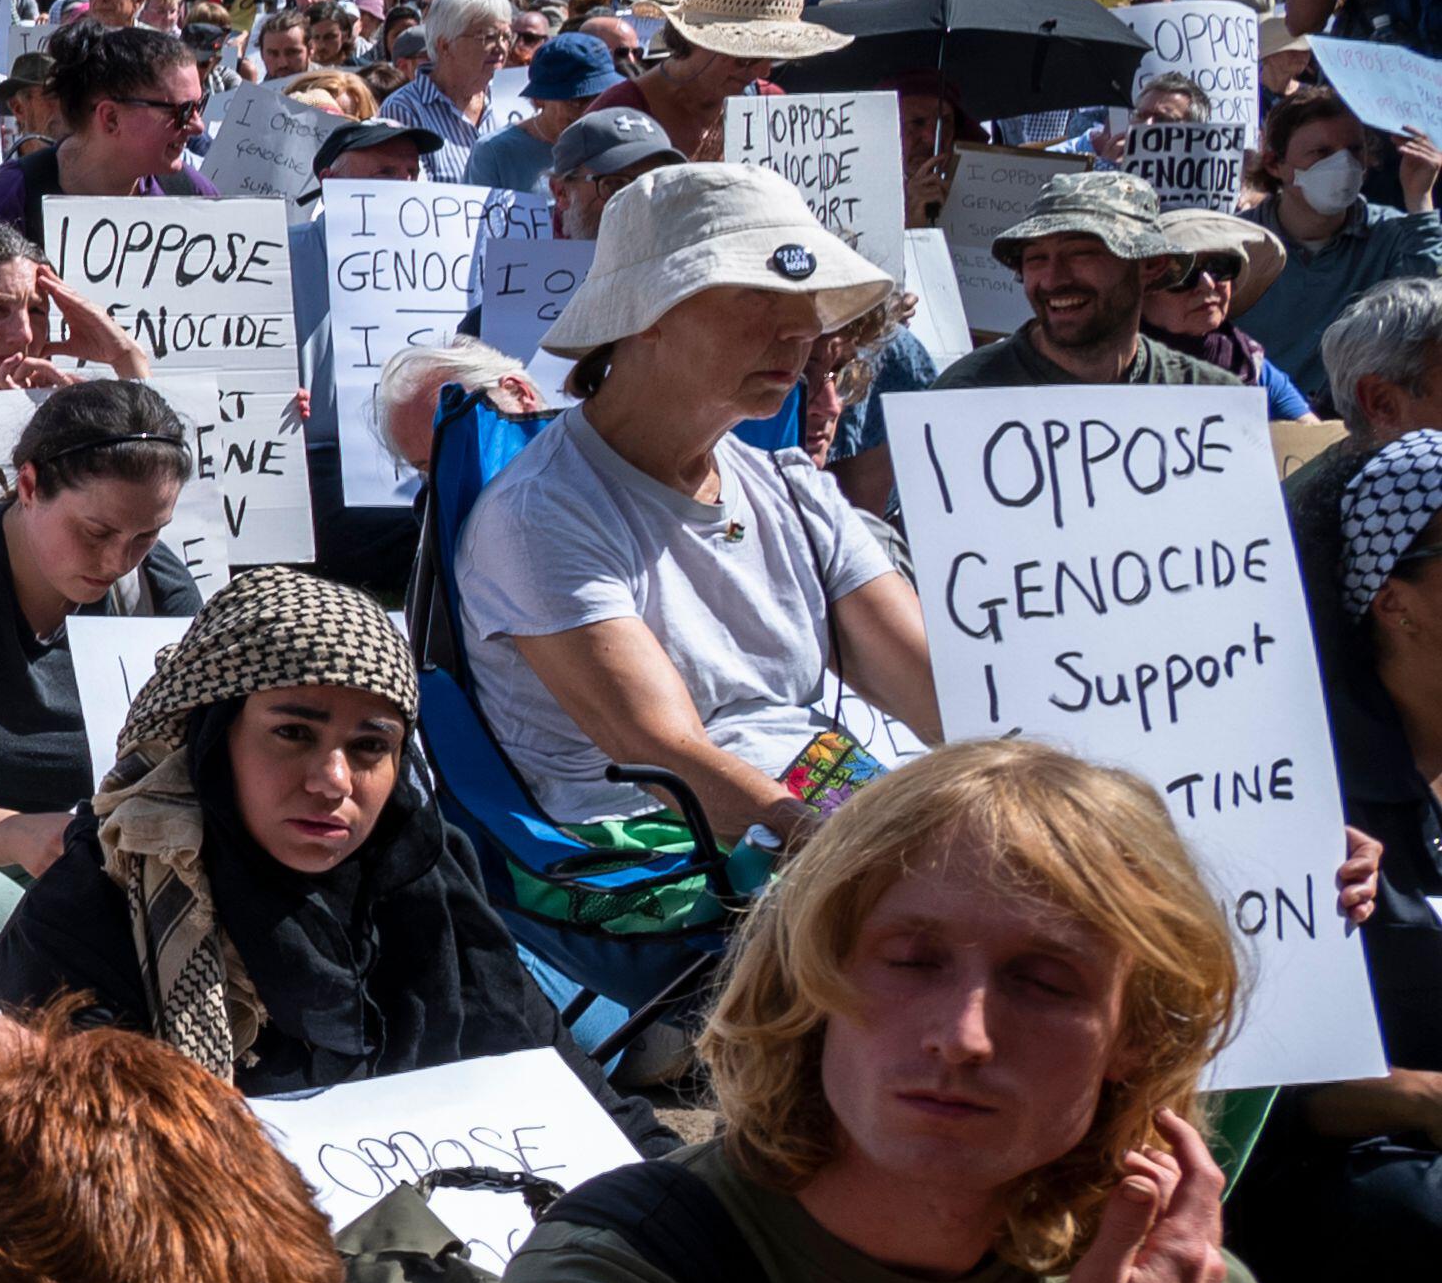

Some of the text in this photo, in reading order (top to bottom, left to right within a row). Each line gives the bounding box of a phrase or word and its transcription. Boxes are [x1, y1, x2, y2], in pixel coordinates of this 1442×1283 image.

[1153, 11, 1259, 65] OPPOSE
[235, 98, 327, 144] I OPPOSE
[742, 100, 856, 150] I OPPOSE
[1127, 124, 1246, 156] I OPPOSE
[235, 137, 309, 176] GENOCIDE
[967, 164, 986, 182] I
[350, 193, 552, 240] I OPPOSE
[82, 214, 287, 289] OPPOSE
[496, 262, 528, 296] I
[352, 326, 381, 369] I
[924, 414, 1234, 529] I OPPOSE
[945, 538, 1272, 643] GENOCIDE
[984, 622, 1276, 733] I Support
[316, 1123, 570, 1200] OPPOSE
